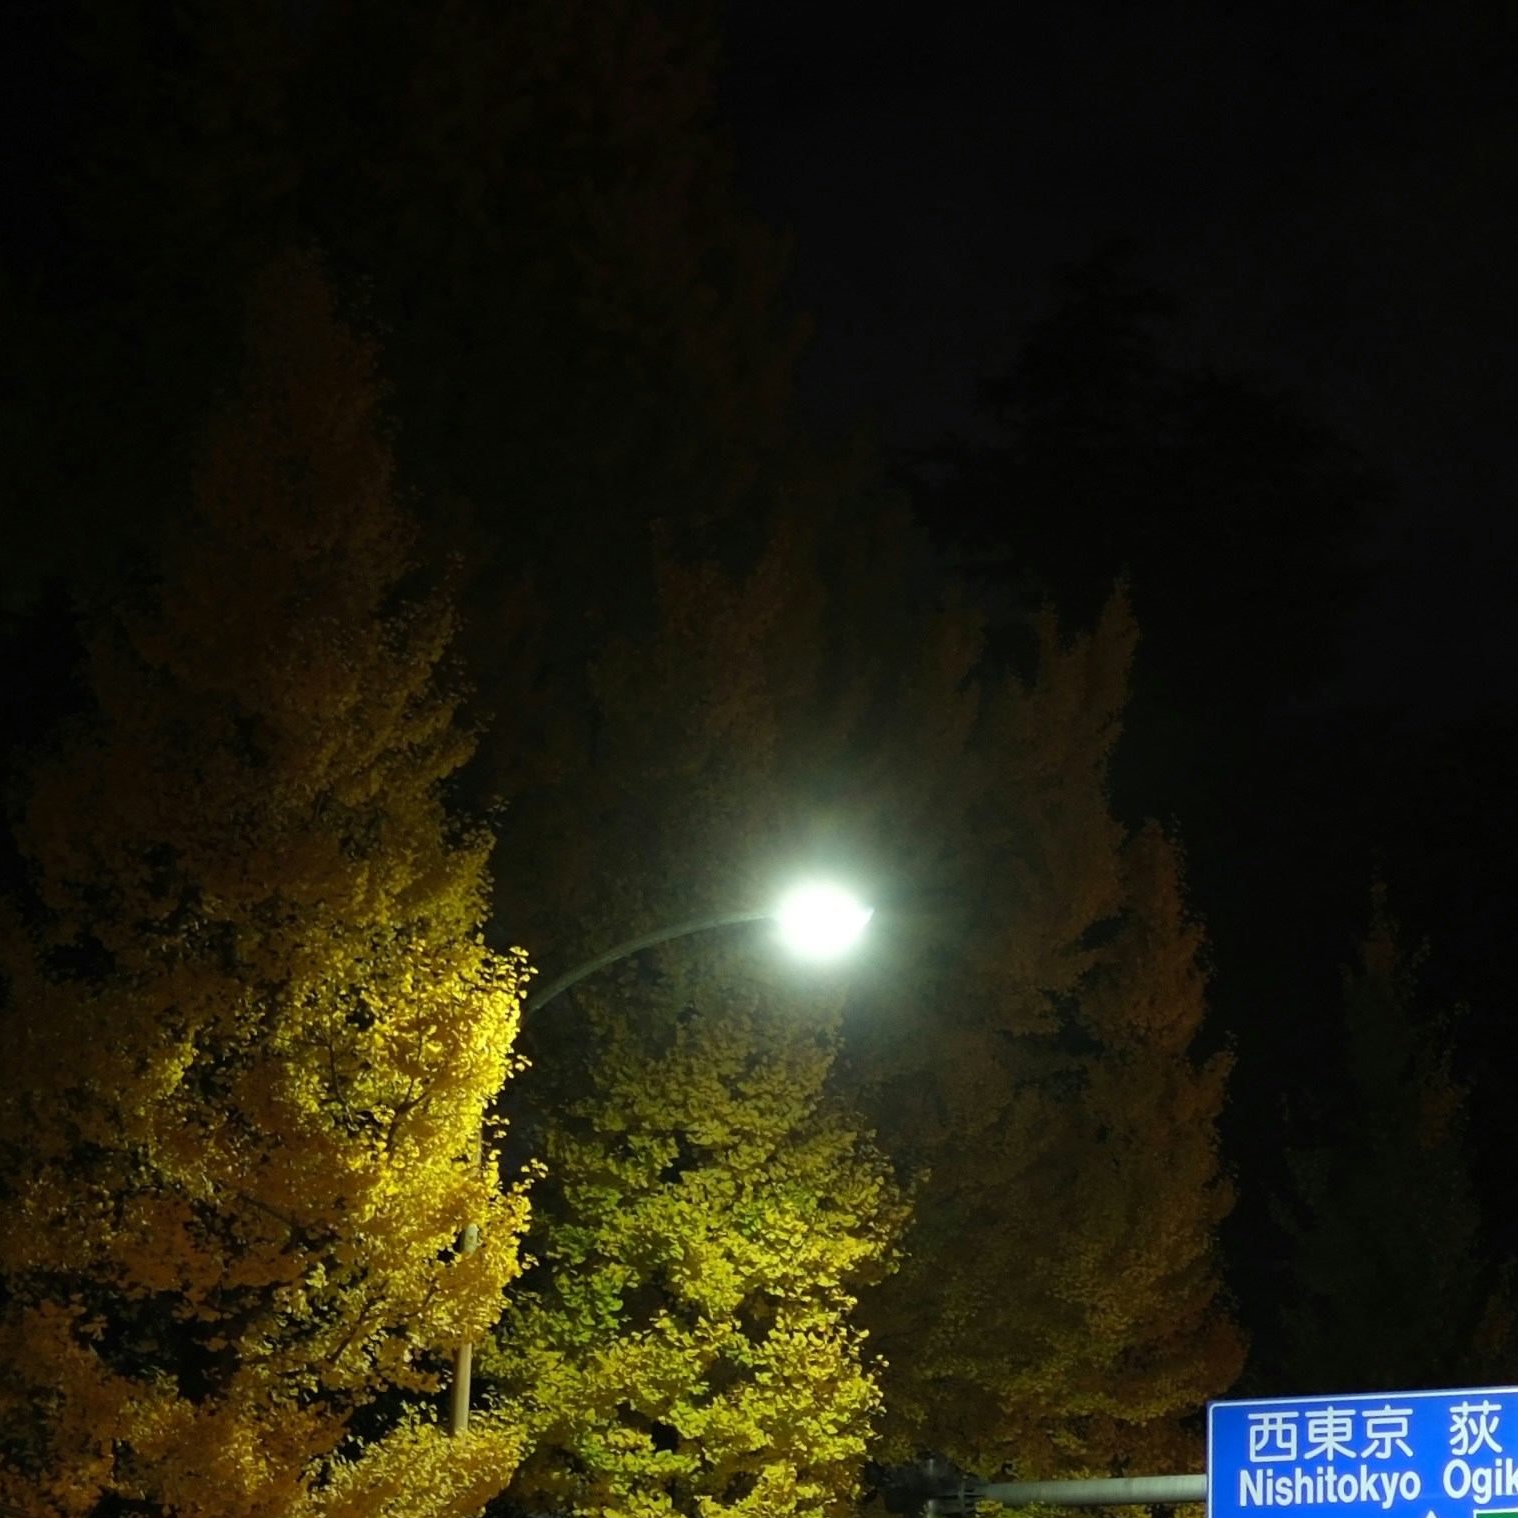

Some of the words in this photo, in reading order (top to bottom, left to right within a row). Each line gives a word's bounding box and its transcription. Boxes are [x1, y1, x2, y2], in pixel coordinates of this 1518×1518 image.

[1247, 1405, 1414, 1463] 西東京
[1239, 1464, 1421, 1510] Nishitokyo
